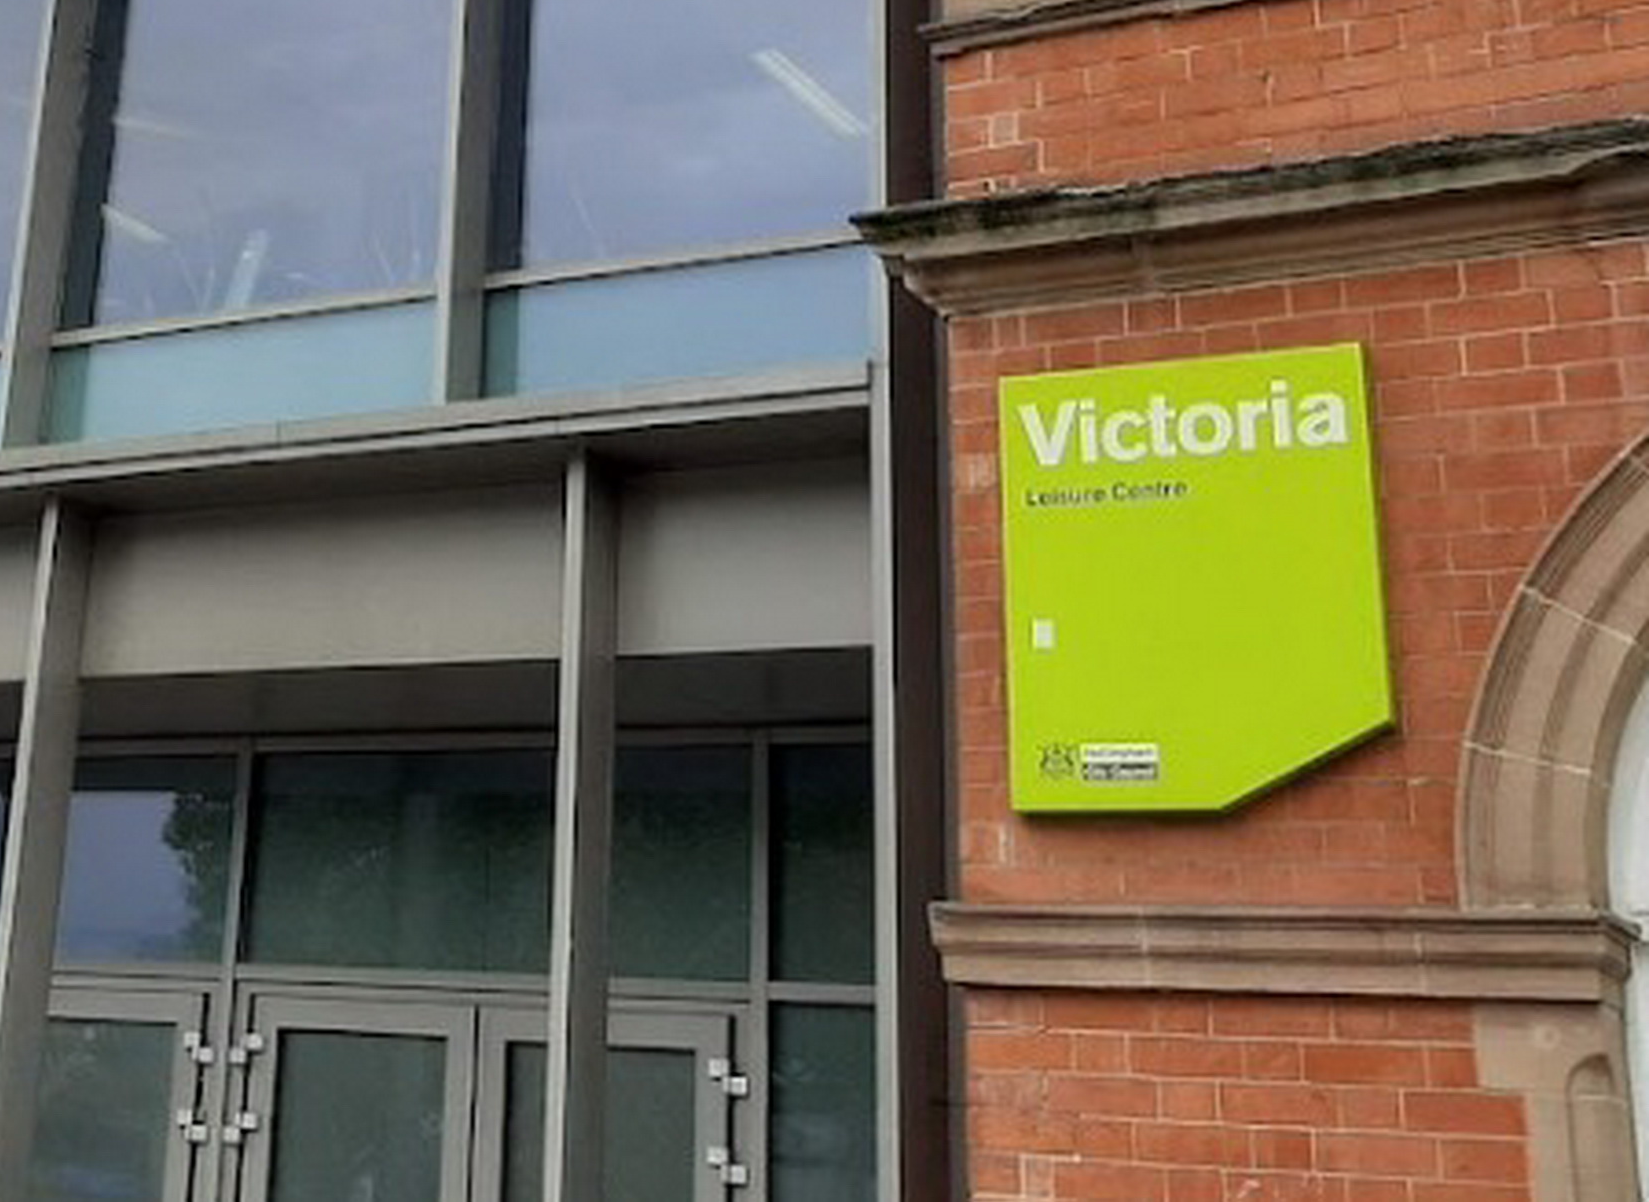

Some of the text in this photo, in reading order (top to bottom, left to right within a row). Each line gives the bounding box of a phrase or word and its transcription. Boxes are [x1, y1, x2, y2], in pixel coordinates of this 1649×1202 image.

[1018, 380, 1348, 467] Victoria
[1026, 479, 1187, 507] Leisure Centre
